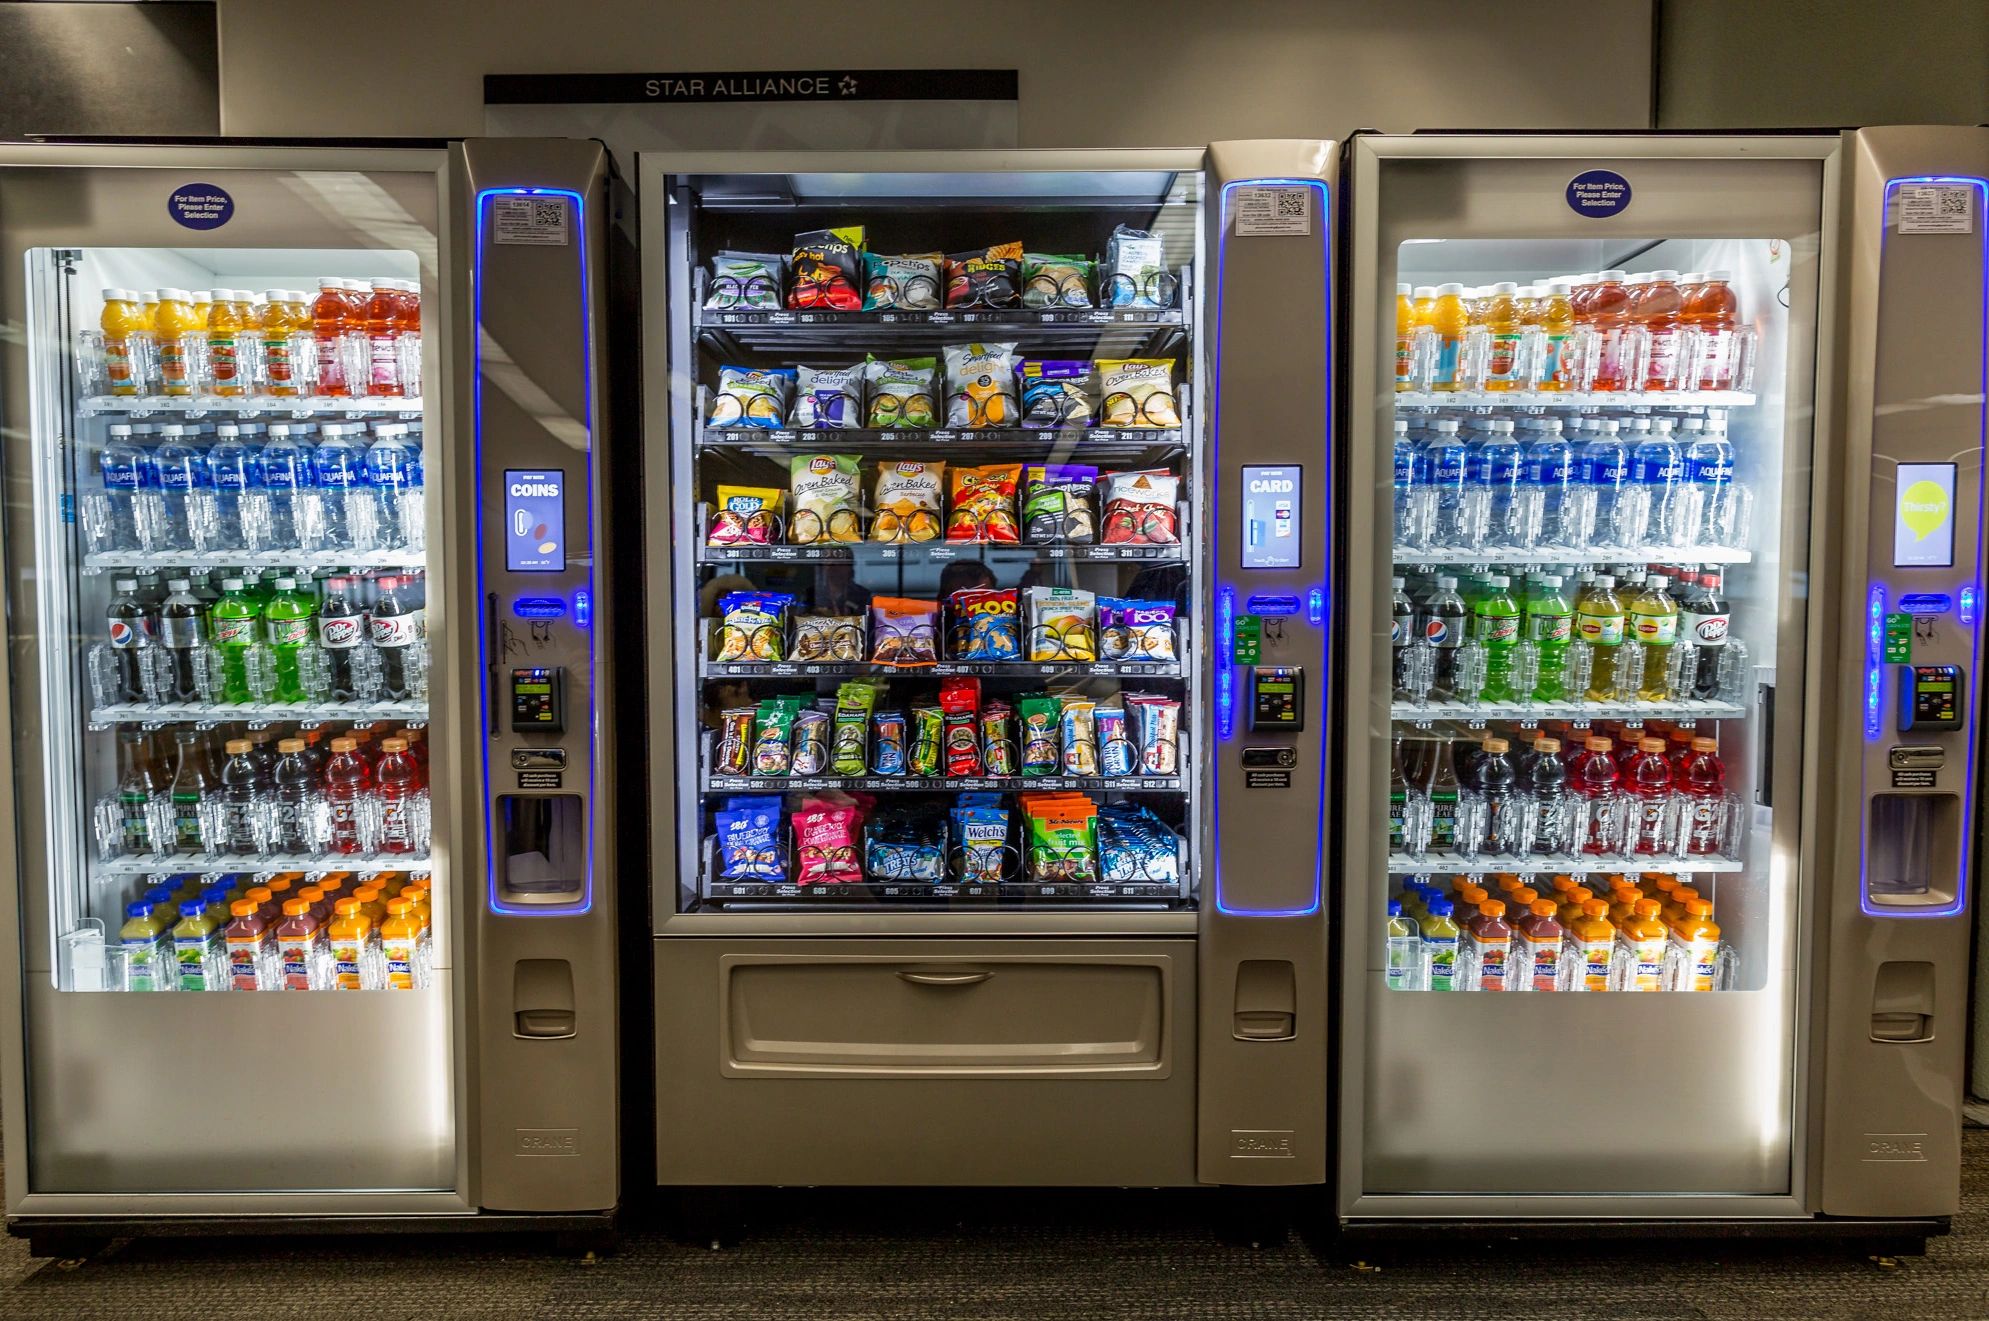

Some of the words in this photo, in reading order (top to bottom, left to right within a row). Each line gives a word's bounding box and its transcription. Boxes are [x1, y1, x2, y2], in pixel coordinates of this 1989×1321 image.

[646, 80, 704, 96] STAR
[713, 78, 830, 95] ALLIANCE
[1604, 183, 1626, 191] Price,
[206, 196, 228, 204] Price,
[874, 260, 930, 271] popchips
[1106, 372, 1133, 386] Oven
[898, 462, 924, 472] Lay's
[795, 482, 820, 496] Oven
[821, 474, 853, 486] Baked
[906, 479, 936, 489] Baked
[1250, 480, 1293, 492] CARD
[511, 484, 559, 497] COINS
[1114, 486, 1170, 497] riceworks
[730, 501, 760, 511] GOLD
[1904, 502, 1946, 514] Thirsty?
[967, 600, 1017, 615] ZOO
[1134, 612, 1169, 623] 100
[968, 827, 1006, 838] Welch's
[884, 857, 917, 874] TREATS
[522, 1137, 574, 1148] CRANE
[1238, 1139, 1289, 1150] CRANE
[1871, 1142, 1921, 1153] CRANE
